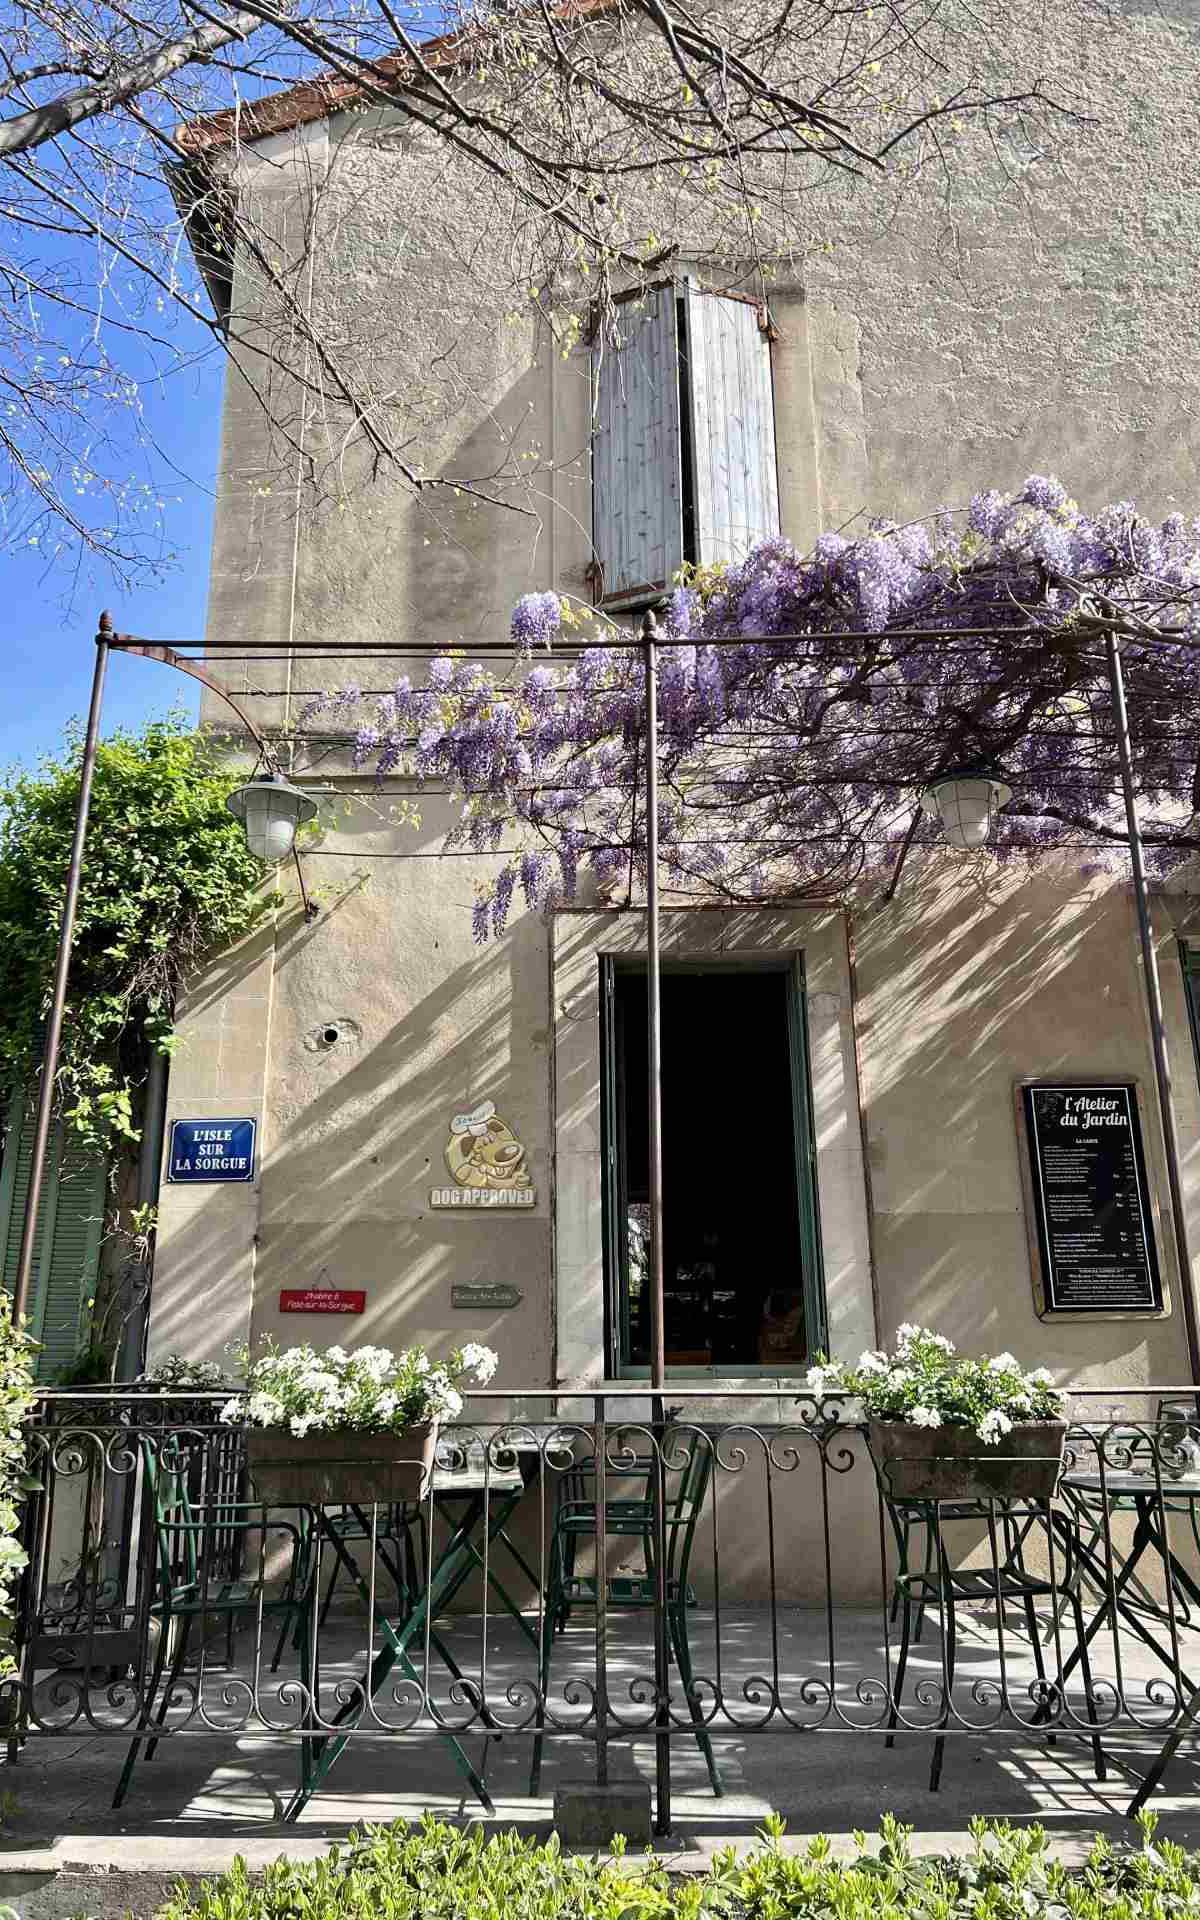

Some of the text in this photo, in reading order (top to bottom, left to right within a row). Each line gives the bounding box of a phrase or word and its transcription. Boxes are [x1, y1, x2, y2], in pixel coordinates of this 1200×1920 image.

[1060, 1112, 1128, 1129] du Jardin
[193, 1129, 233, 1142] L'ISLE
[198, 1143, 224, 1156] SUR
[175, 1157, 248, 1171] LA SORGUE
[431, 1188, 534, 1205] DOG APPROVED
